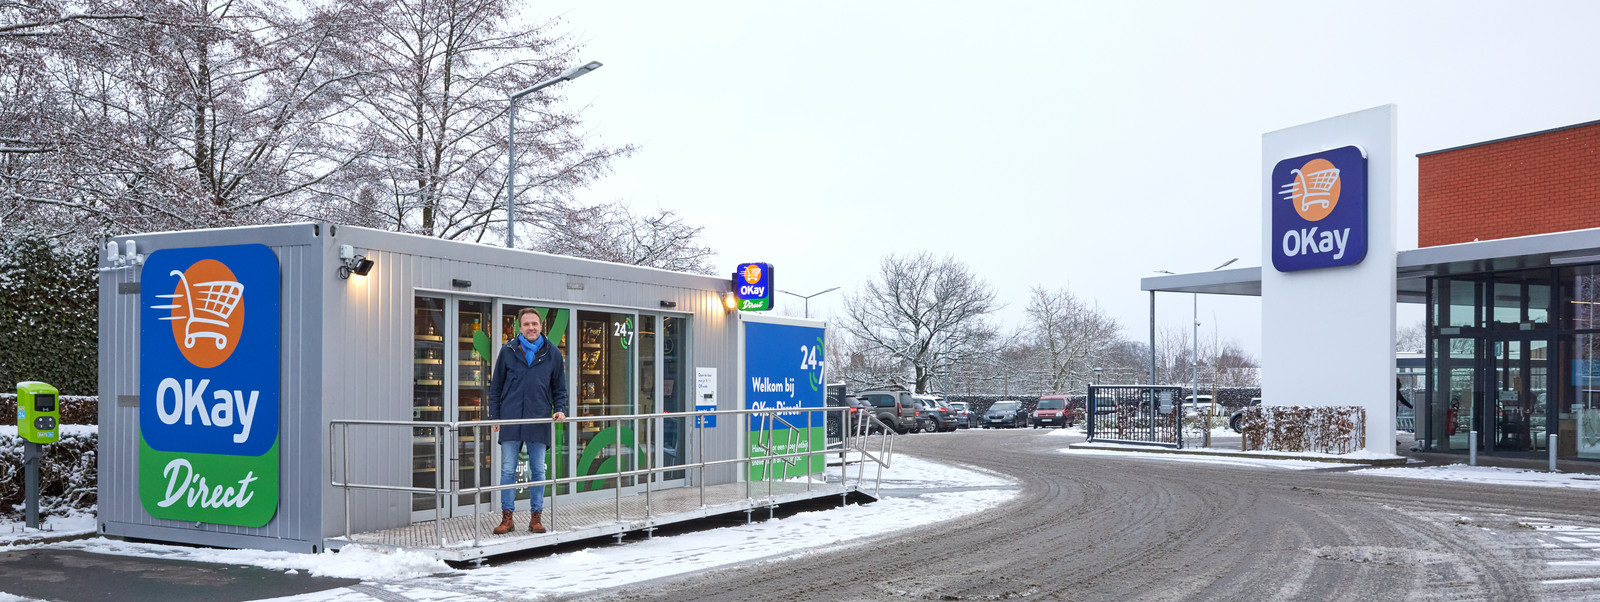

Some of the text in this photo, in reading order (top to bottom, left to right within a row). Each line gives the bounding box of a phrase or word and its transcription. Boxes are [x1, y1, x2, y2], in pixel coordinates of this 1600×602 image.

[1282, 226, 1351, 260] OKay
[740, 285, 765, 297] OKay
[742, 299, 764, 310] Direct
[613, 321, 634, 346] 24 7
[800, 344, 825, 385] 24 7
[752, 376, 795, 398] Welkom bij
[156, 377, 260, 444] OKay
[752, 400, 775, 416] OK
[157, 458, 259, 509] Direct
